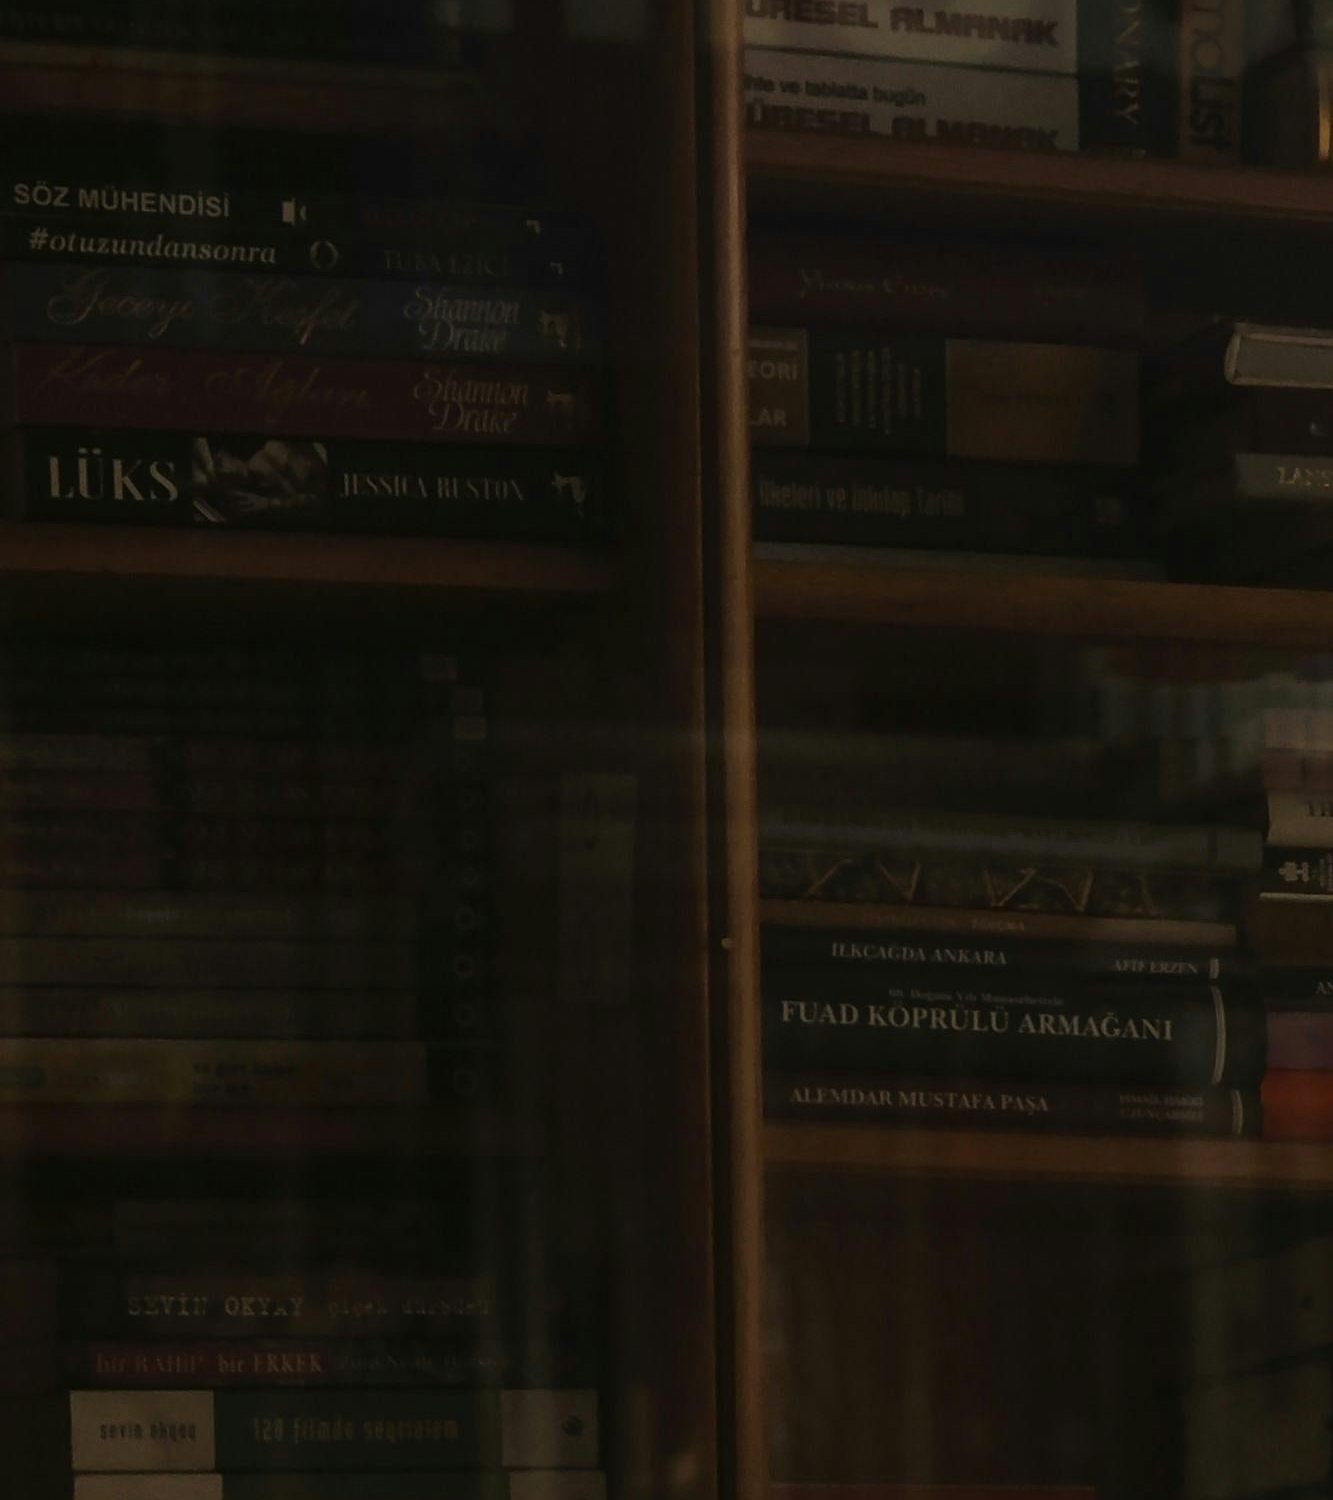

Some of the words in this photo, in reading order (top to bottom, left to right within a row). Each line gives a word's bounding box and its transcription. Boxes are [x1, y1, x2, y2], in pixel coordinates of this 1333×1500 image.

[13, 180, 70, 209] SÖZ
[78, 186, 231, 220] MÜHENDİSİ
[28, 226, 278, 265] #otuzundansonra
[403, 284, 522, 327] Shannon
[420, 317, 511, 356] Drake
[412, 368, 531, 412] Shannon
[429, 404, 519, 436] Drake
[47, 445, 180, 504] LÜKS
[830, 940, 926, 968] İLKÇAĞDA
[933, 945, 1009, 969] ANKARA
[780, 999, 861, 1028] FUAD
[867, 1001, 1012, 1036] KÖPRÜLÜ
[1017, 1008, 1174, 1044] ARMAĞANI
[897, 1089, 996, 1113] MUSTAFA
